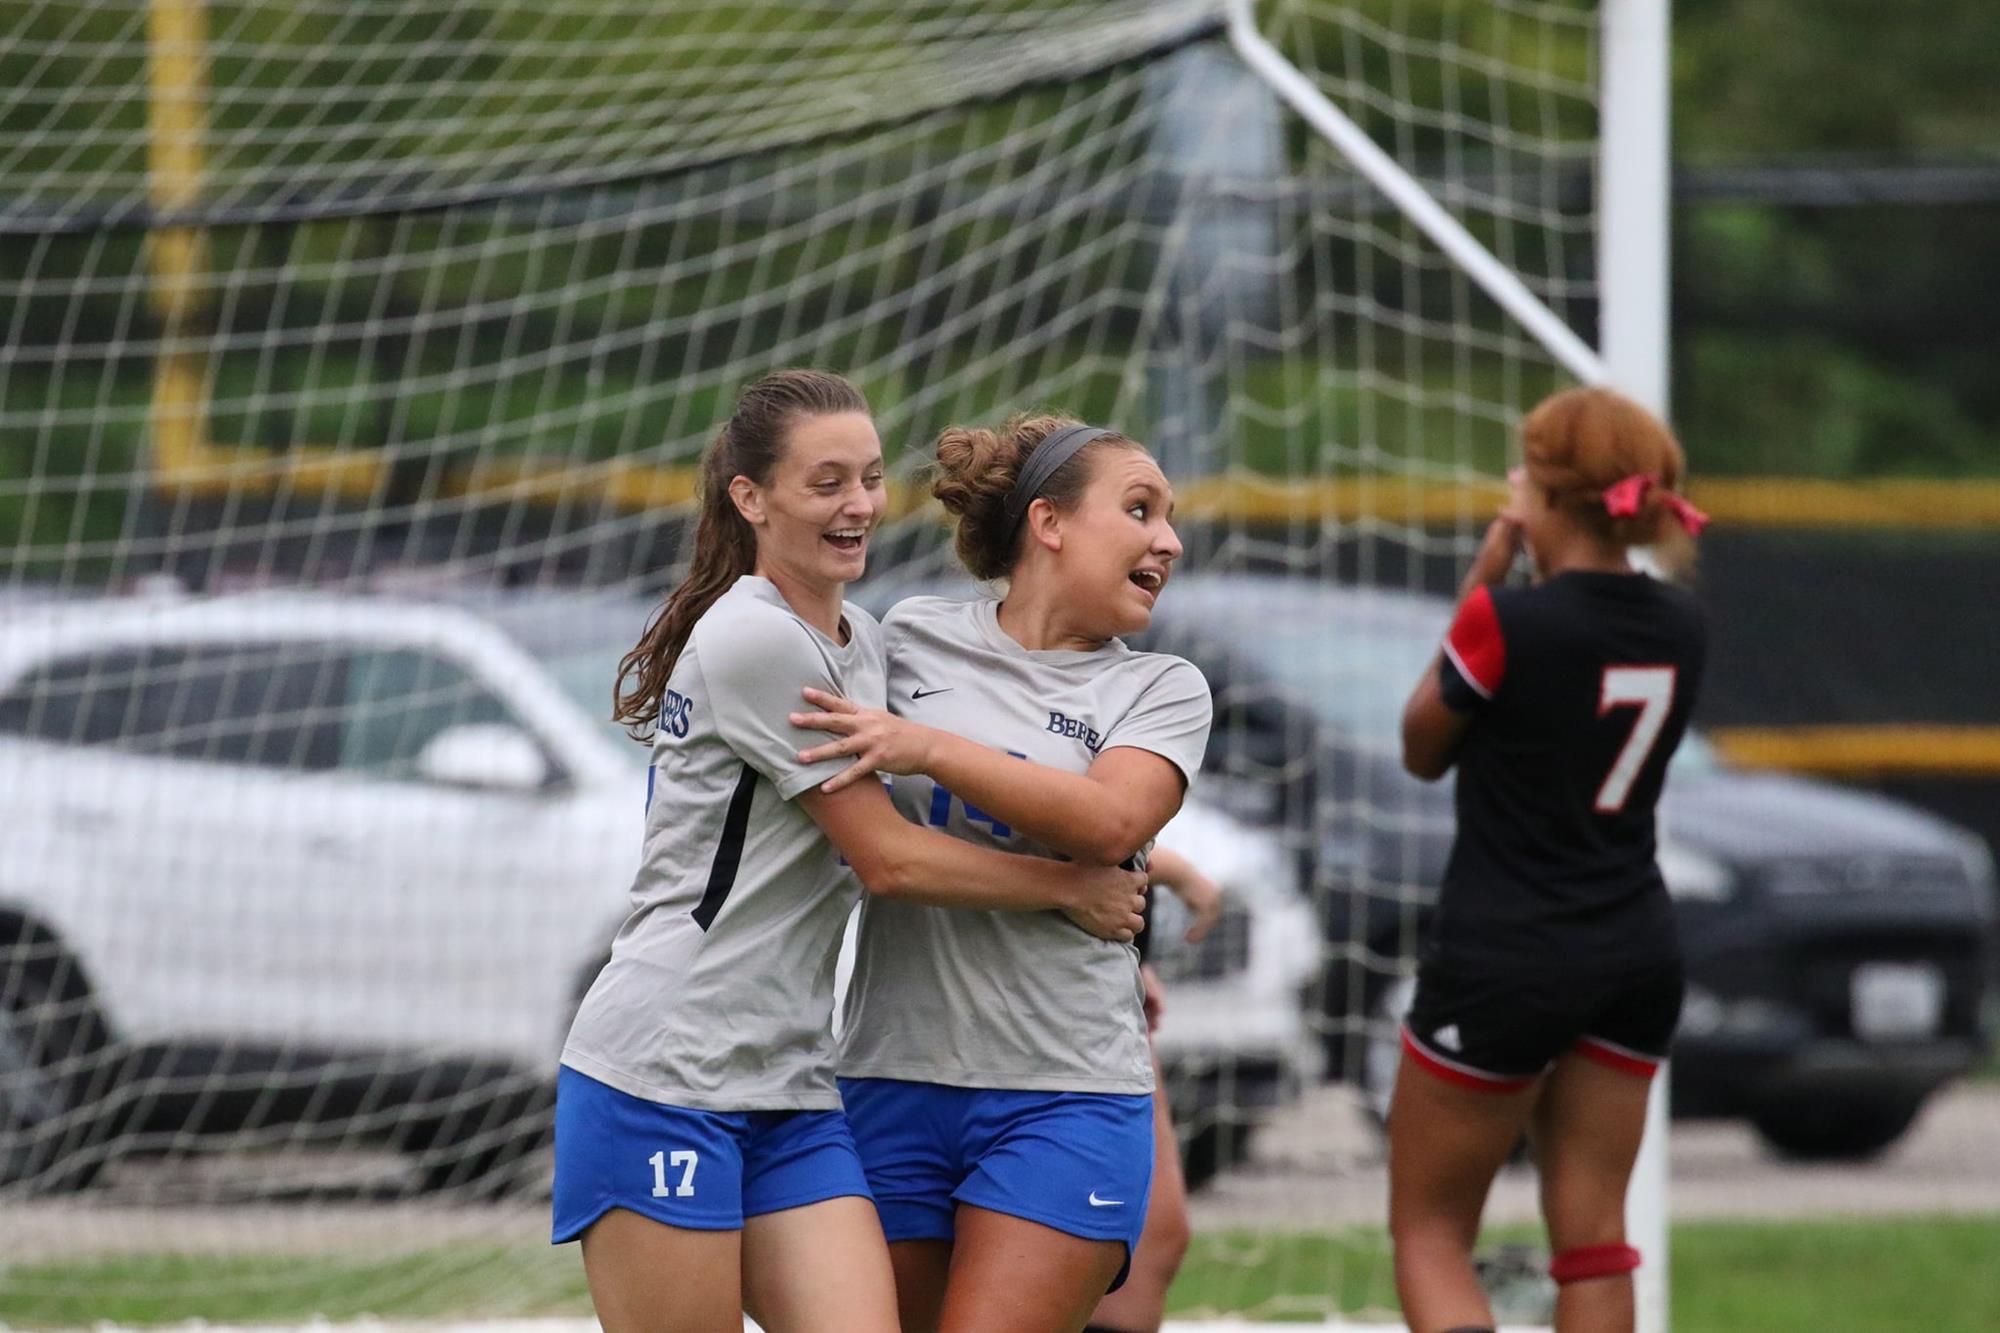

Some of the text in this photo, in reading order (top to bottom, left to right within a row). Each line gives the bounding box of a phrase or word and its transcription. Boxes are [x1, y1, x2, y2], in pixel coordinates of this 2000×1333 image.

[1045, 711, 1101, 754] BERE
[1594, 664, 1678, 813] 7
[648, 1150, 699, 1198] 17
